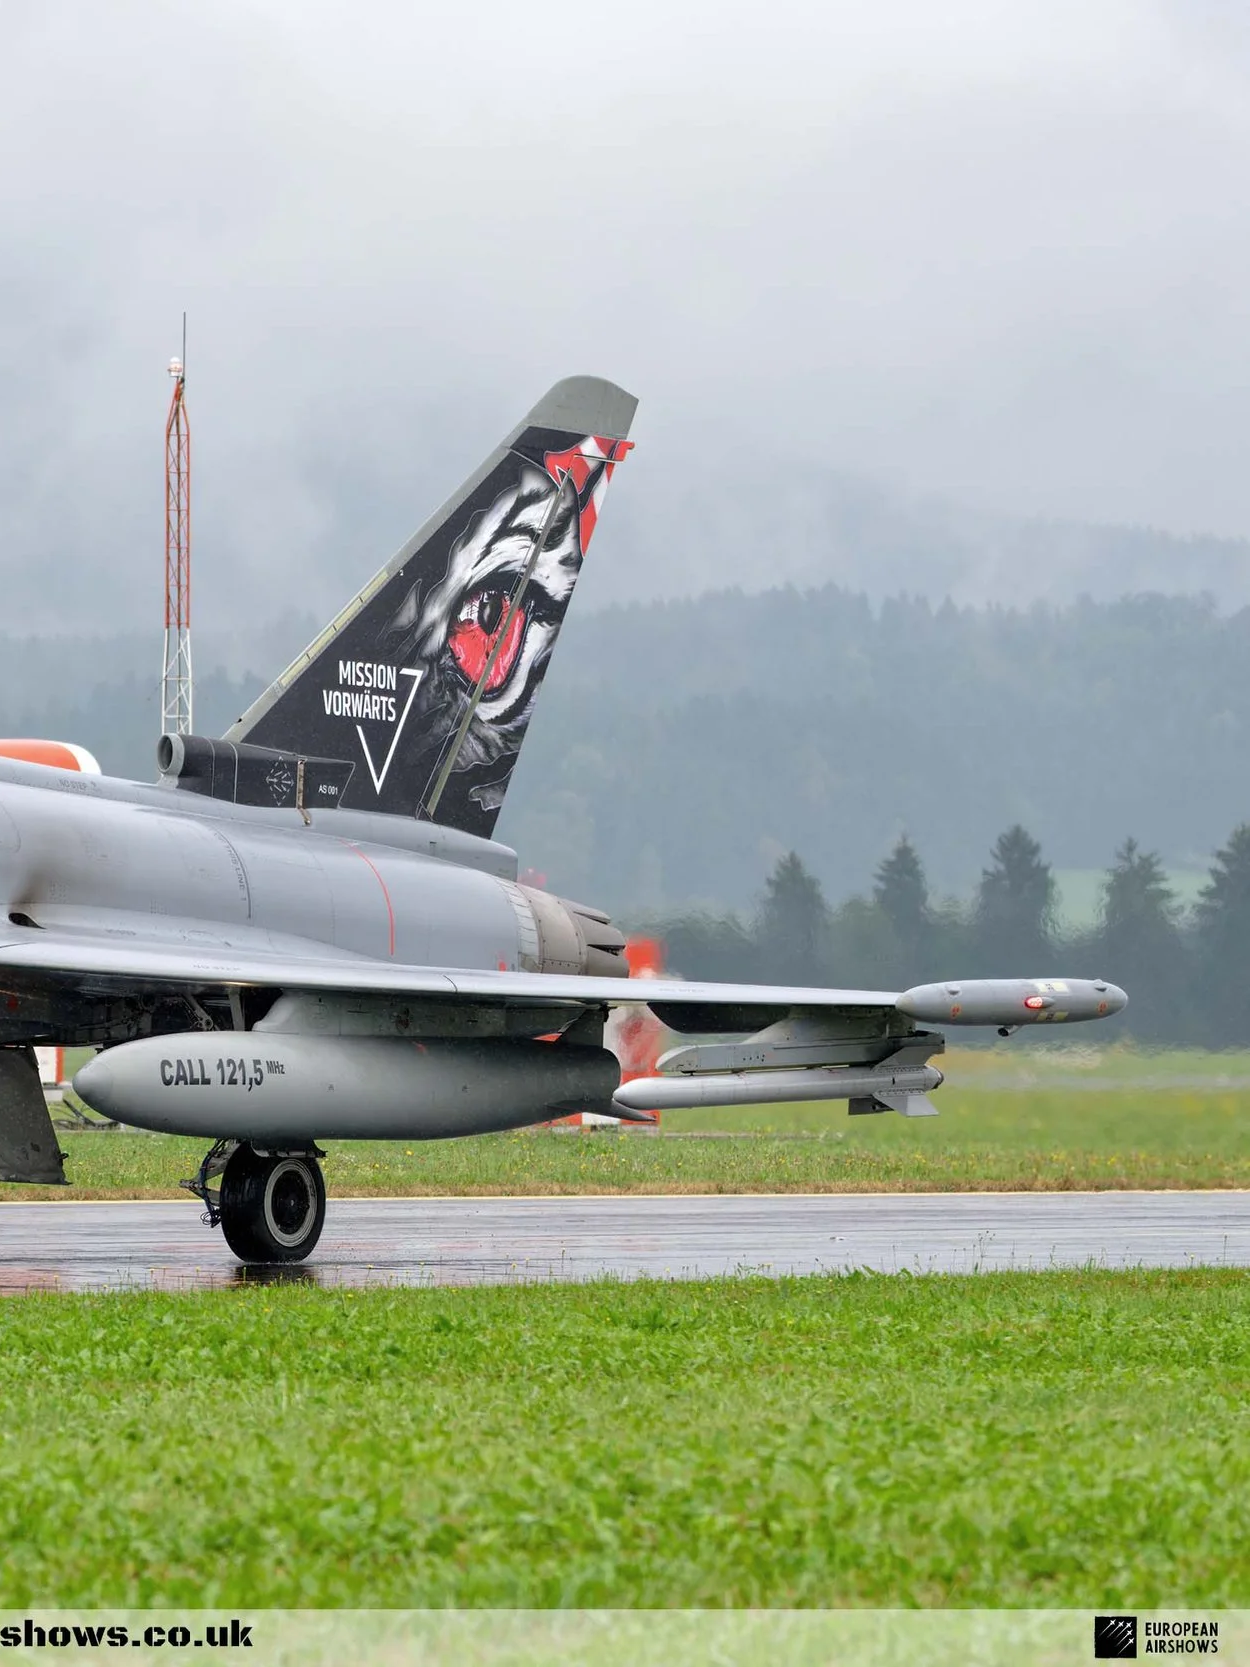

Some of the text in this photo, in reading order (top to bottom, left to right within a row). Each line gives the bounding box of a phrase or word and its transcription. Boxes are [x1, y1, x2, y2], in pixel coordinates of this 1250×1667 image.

[338, 660, 396, 690] MISSION
[323, 689, 396, 721] VORWÄRTS
[318, 784, 338, 795] AS 001
[160, 1058, 285, 1092] CALL 121,5 MHz
